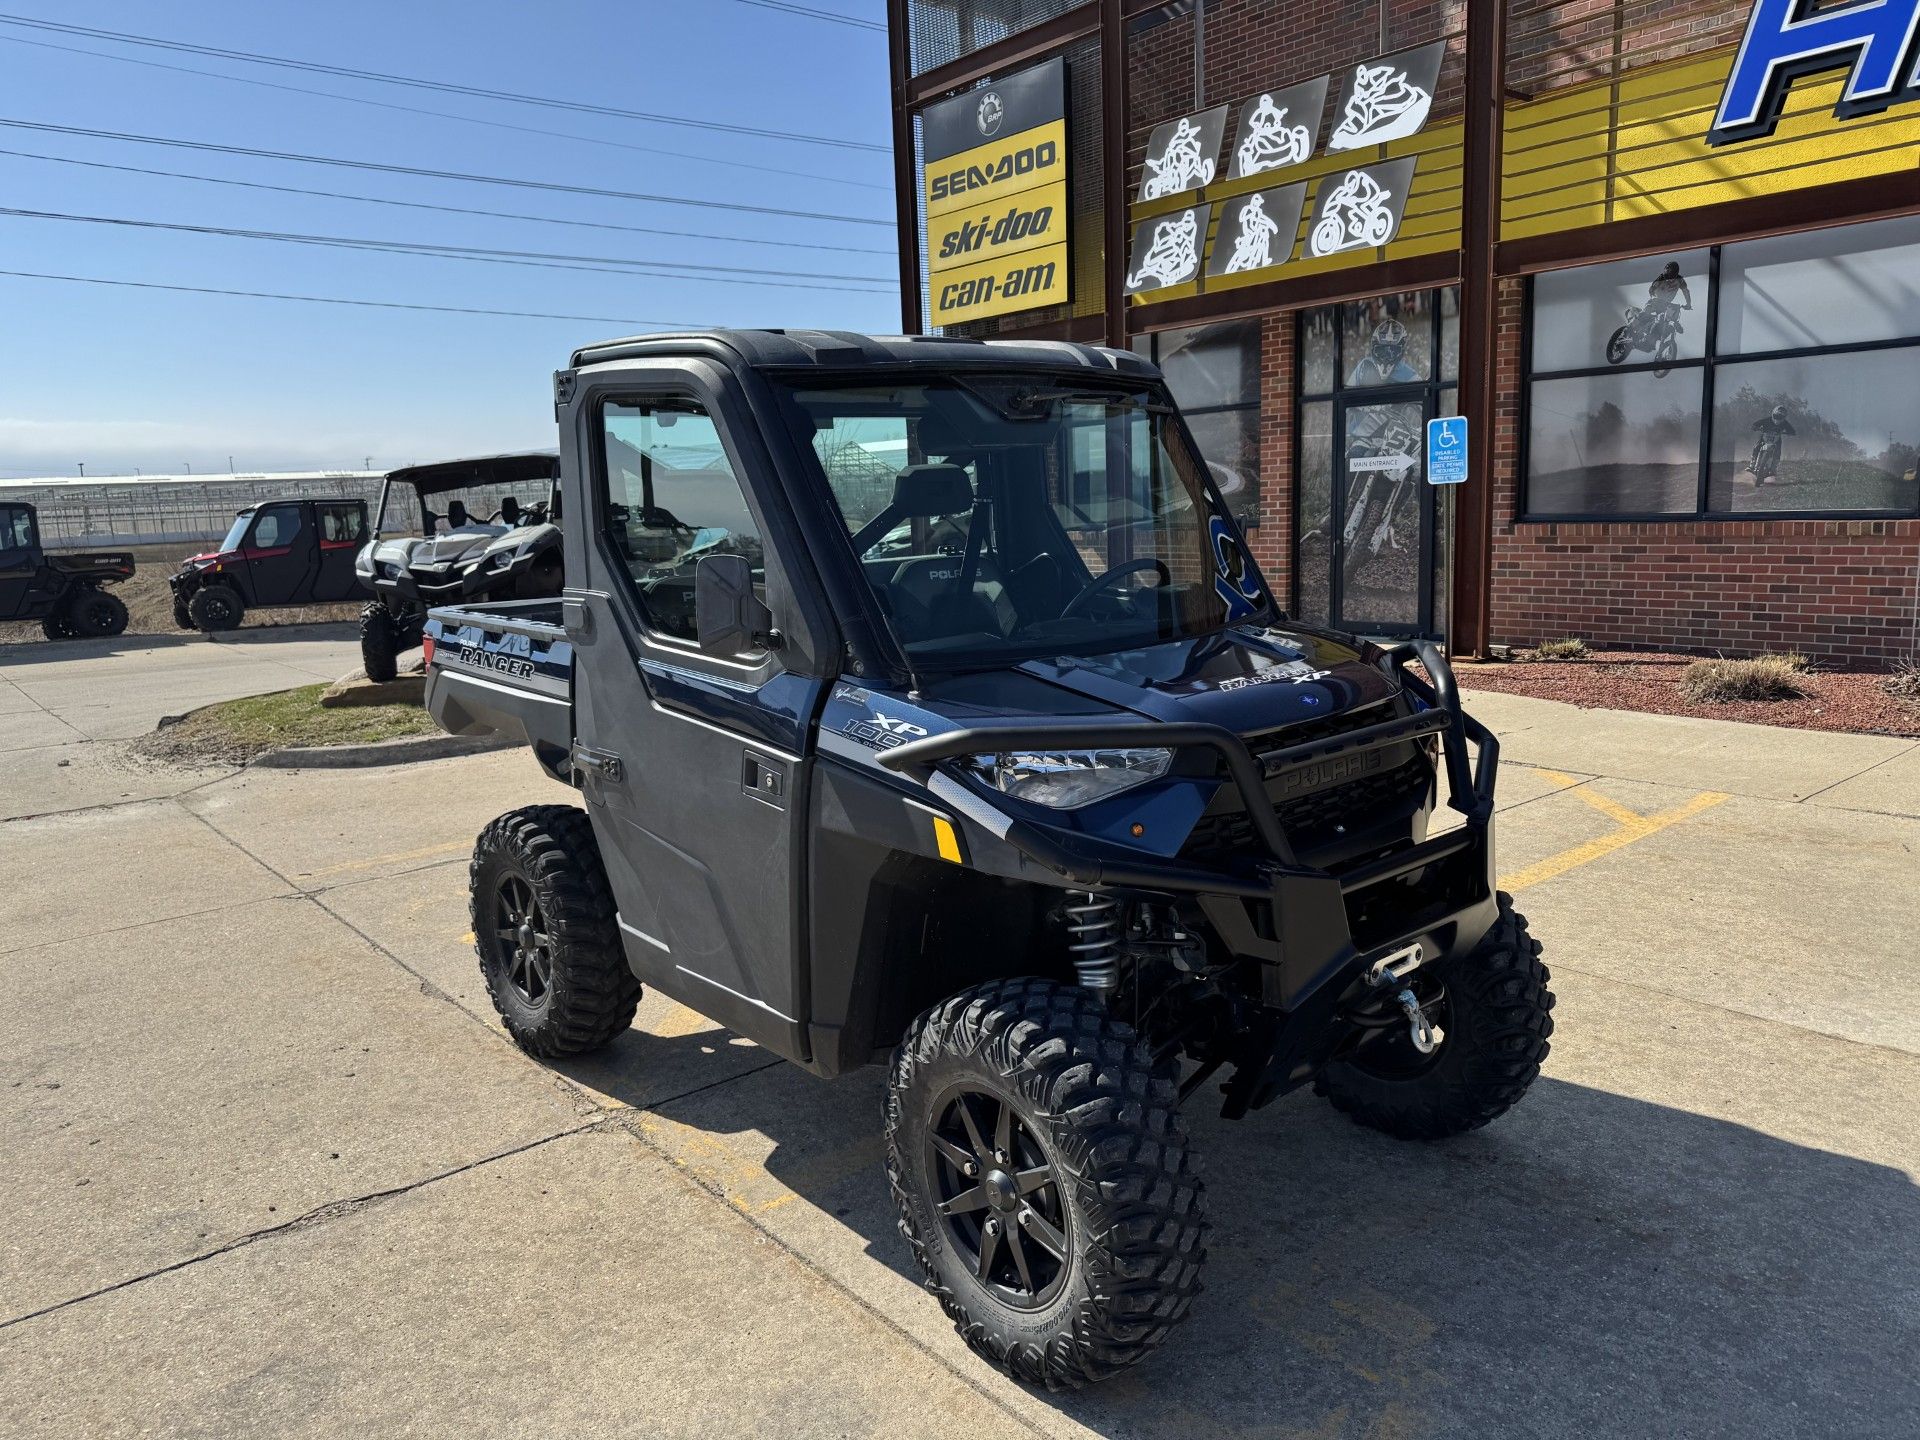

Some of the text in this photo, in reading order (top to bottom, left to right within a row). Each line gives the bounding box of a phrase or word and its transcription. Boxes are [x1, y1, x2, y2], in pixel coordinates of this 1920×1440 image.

[1711, 0, 1920, 132] H
[938, 206, 1054, 259] ski-doo
[938, 261, 1056, 311] can-am
[1353, 459, 1398, 468] MAIN ENTRANCE
[929, 567, 982, 580] POLAS
[459, 647, 535, 681] RANGER
[1291, 669, 1332, 685] XP
[843, 719, 908, 751] 100
[865, 711, 929, 736] XP
[863, 740, 887, 752] OVER
[1284, 750, 1381, 795] POLARIS
